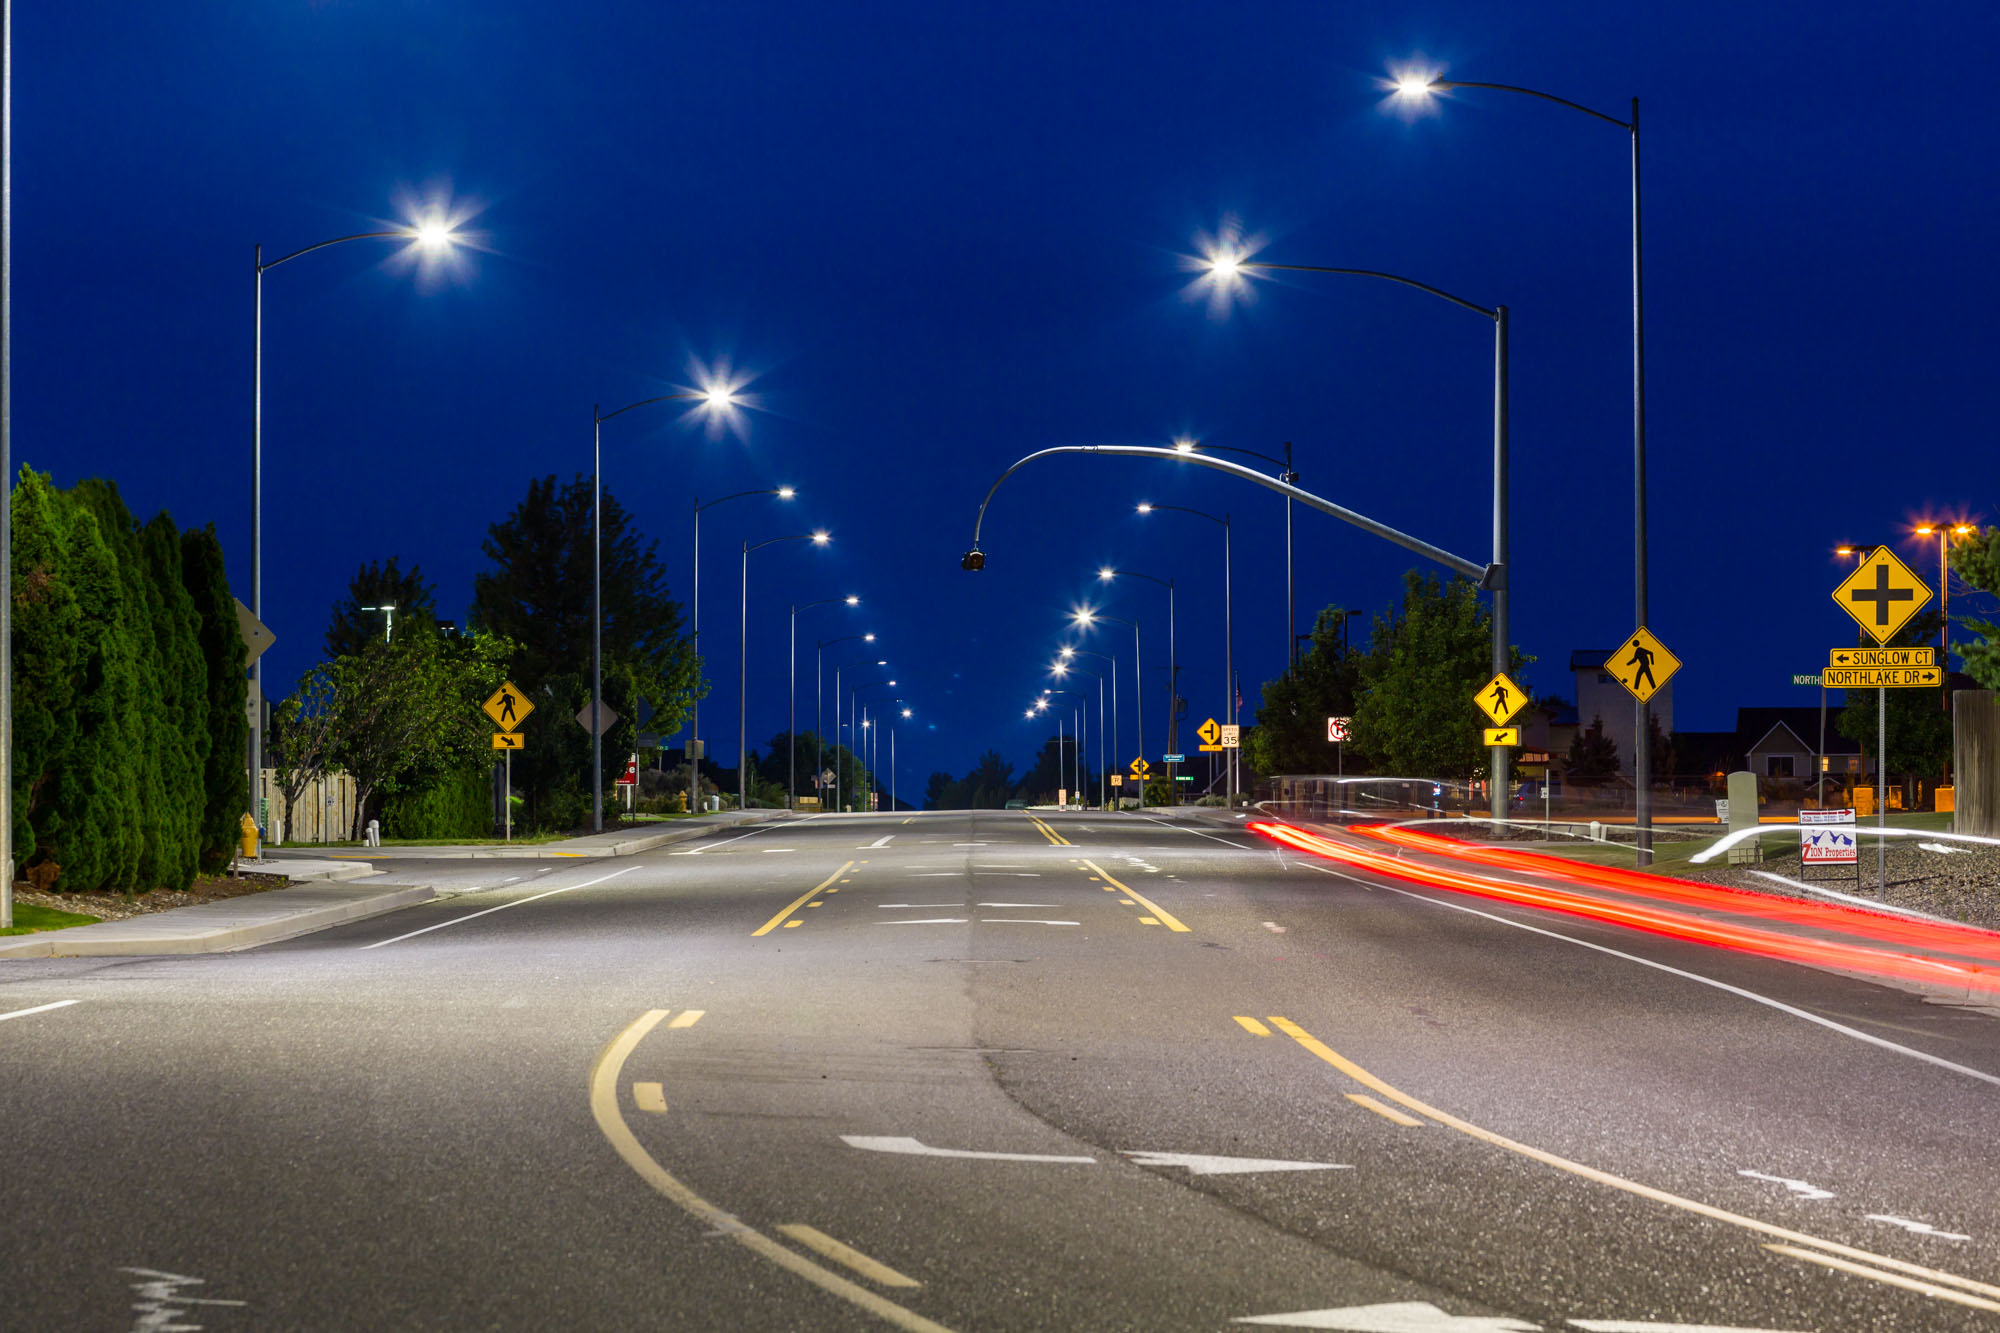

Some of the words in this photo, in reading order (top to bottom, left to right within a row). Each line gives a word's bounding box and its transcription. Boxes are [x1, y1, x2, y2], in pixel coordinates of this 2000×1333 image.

[1852, 651, 1910, 664] SUNGLOW
[1915, 651, 1930, 664] CT
[1827, 671, 1900, 684] NORTHLAKE
[1904, 670, 1920, 683] DR
[1223, 736, 1237, 745] 35
[1825, 847, 1856, 857] Properties
